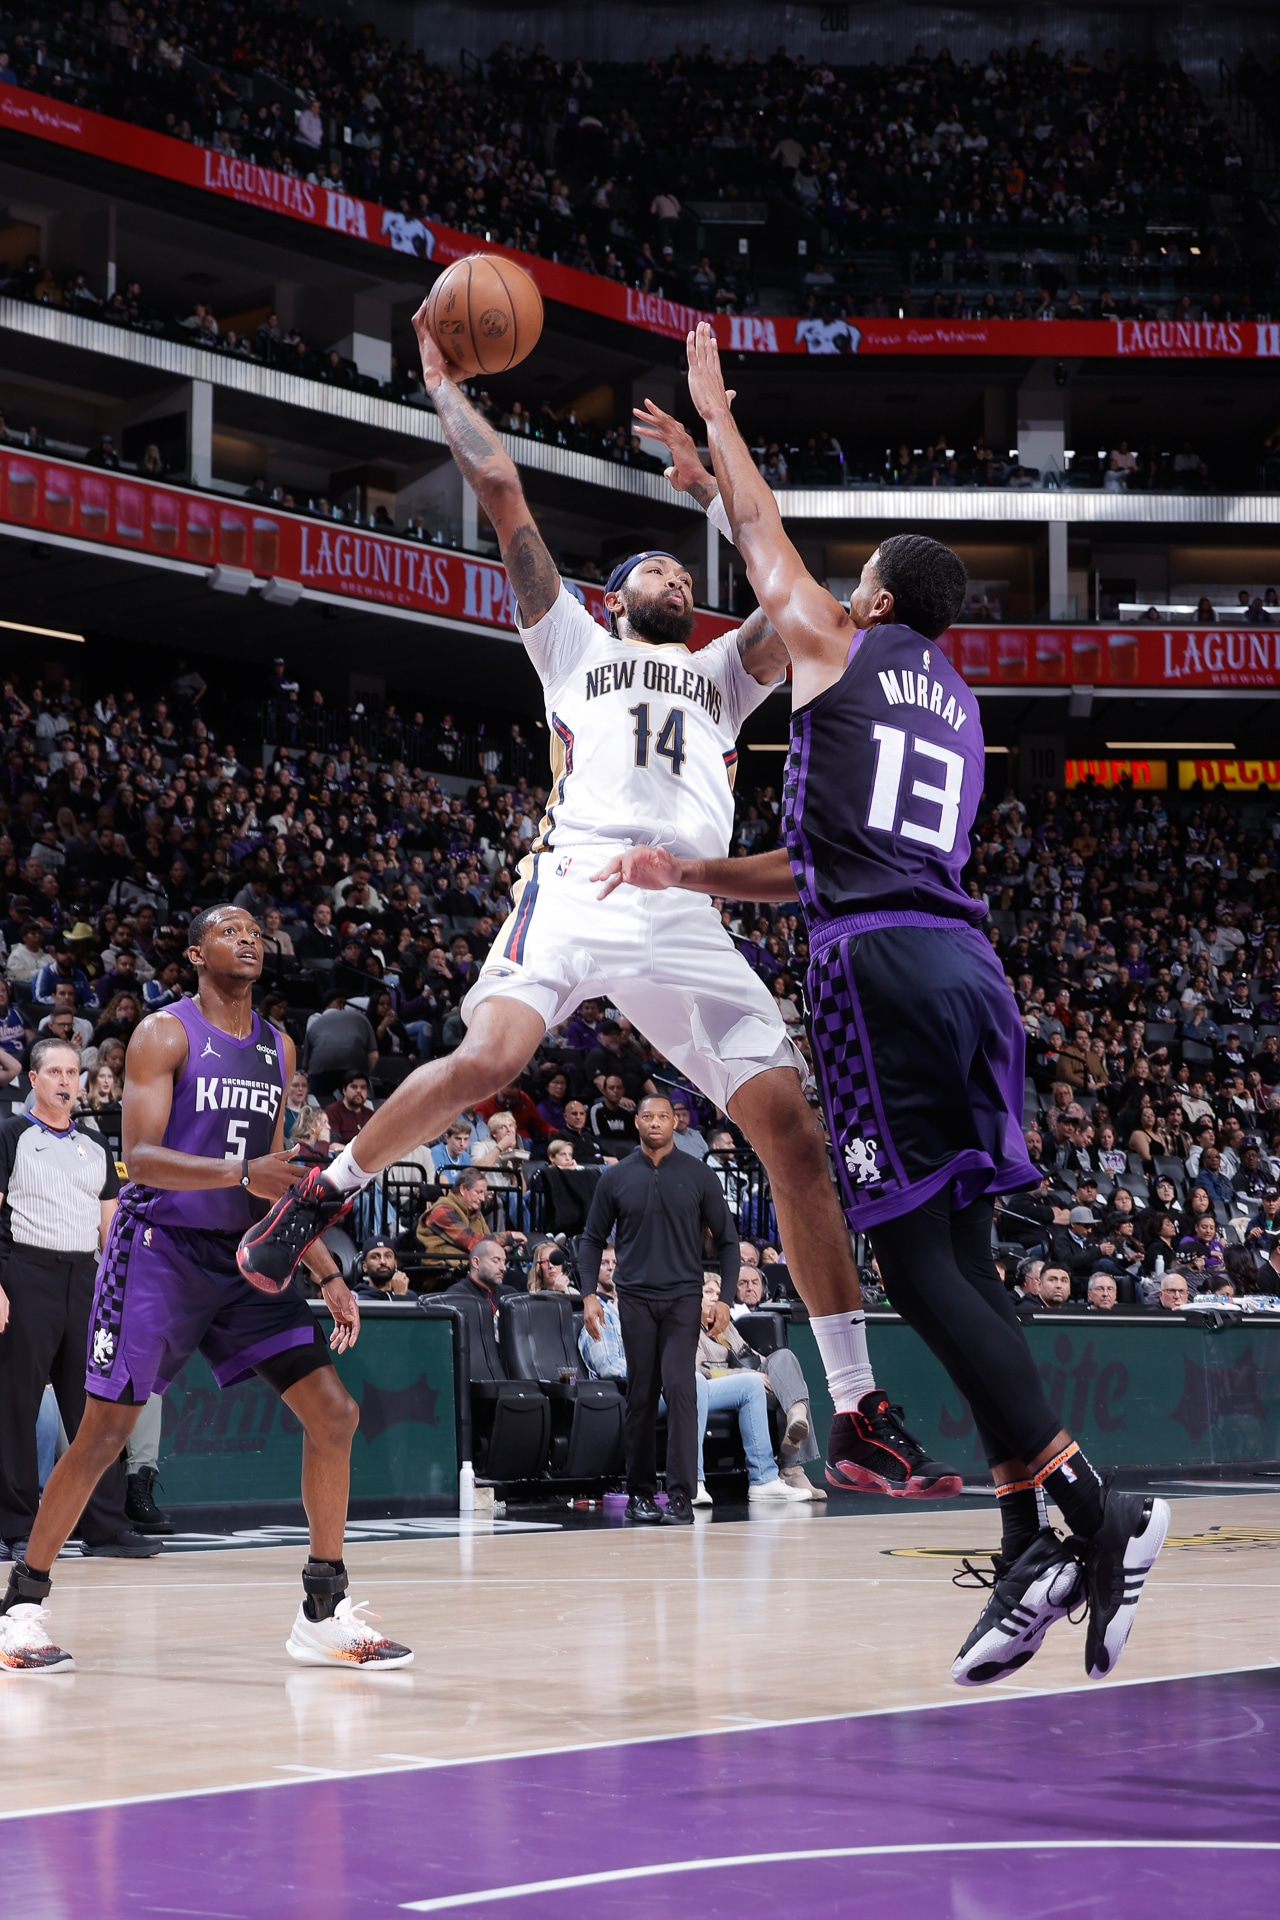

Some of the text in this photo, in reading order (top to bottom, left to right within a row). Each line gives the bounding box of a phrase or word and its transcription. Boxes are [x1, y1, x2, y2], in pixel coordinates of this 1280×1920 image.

[204, 151, 369, 239] LAGUNITAS IPA
[626, 287, 779, 352] LAGUNITS IPA
[1116, 321, 1243, 354] LAGUNITAS
[300, 525, 449, 605] LAGUNITAS
[585, 659, 722, 725] NEW ORLEANS
[877, 669, 967, 732] MURRAY
[628, 702, 686, 777] 14
[864, 720, 965, 853] 13
[221, 1077, 270, 1090] SACRAMENTO
[224, 1119, 250, 1160] 5
